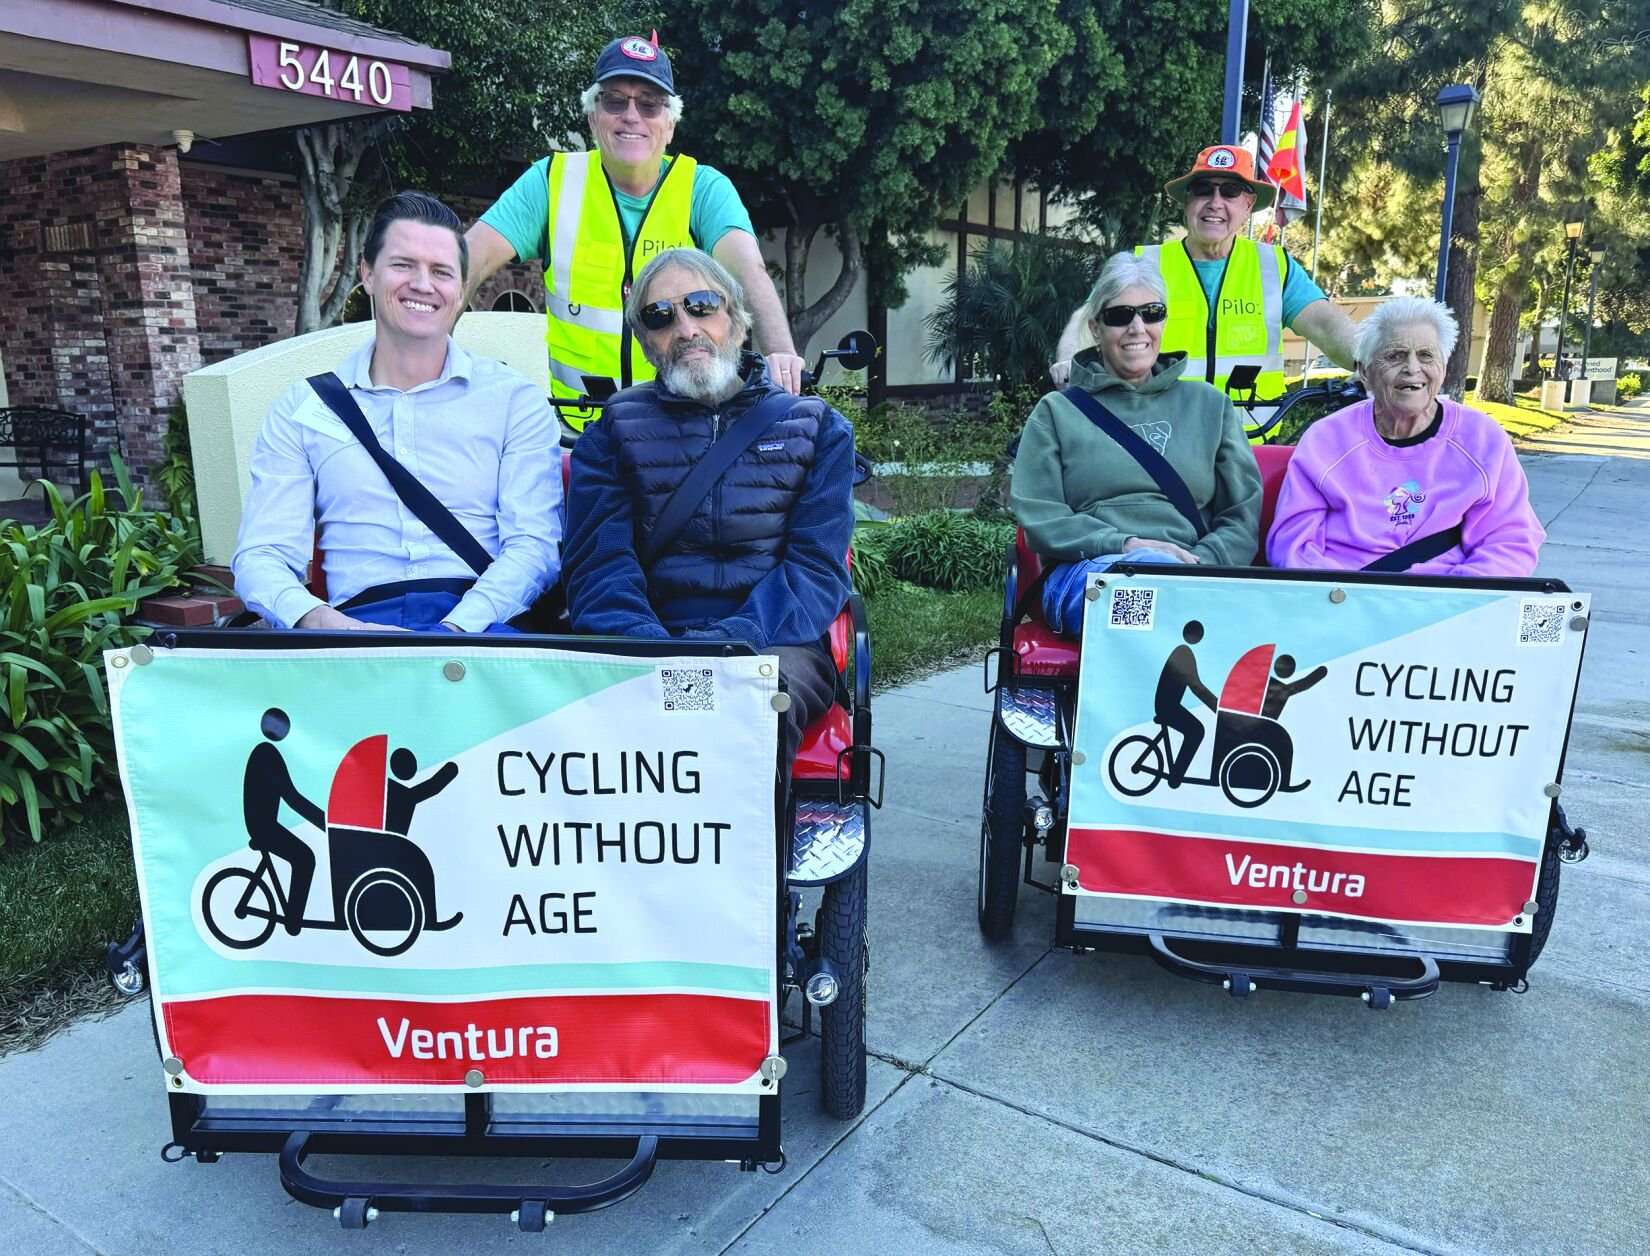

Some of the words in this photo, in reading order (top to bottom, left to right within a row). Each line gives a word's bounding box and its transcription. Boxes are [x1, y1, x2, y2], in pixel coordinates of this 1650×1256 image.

[279, 42, 392, 105] 5440
[1355, 662, 1516, 703] CYCLING
[1349, 716, 1529, 757] WITHOUT
[497, 750, 700, 796] CYCLING
[1337, 770, 1415, 807] AGE
[497, 821, 731, 867] WITHOUT
[1225, 853, 1365, 897] Ventura
[503, 891, 597, 936] AGE
[376, 1017, 559, 1061] Ventura
